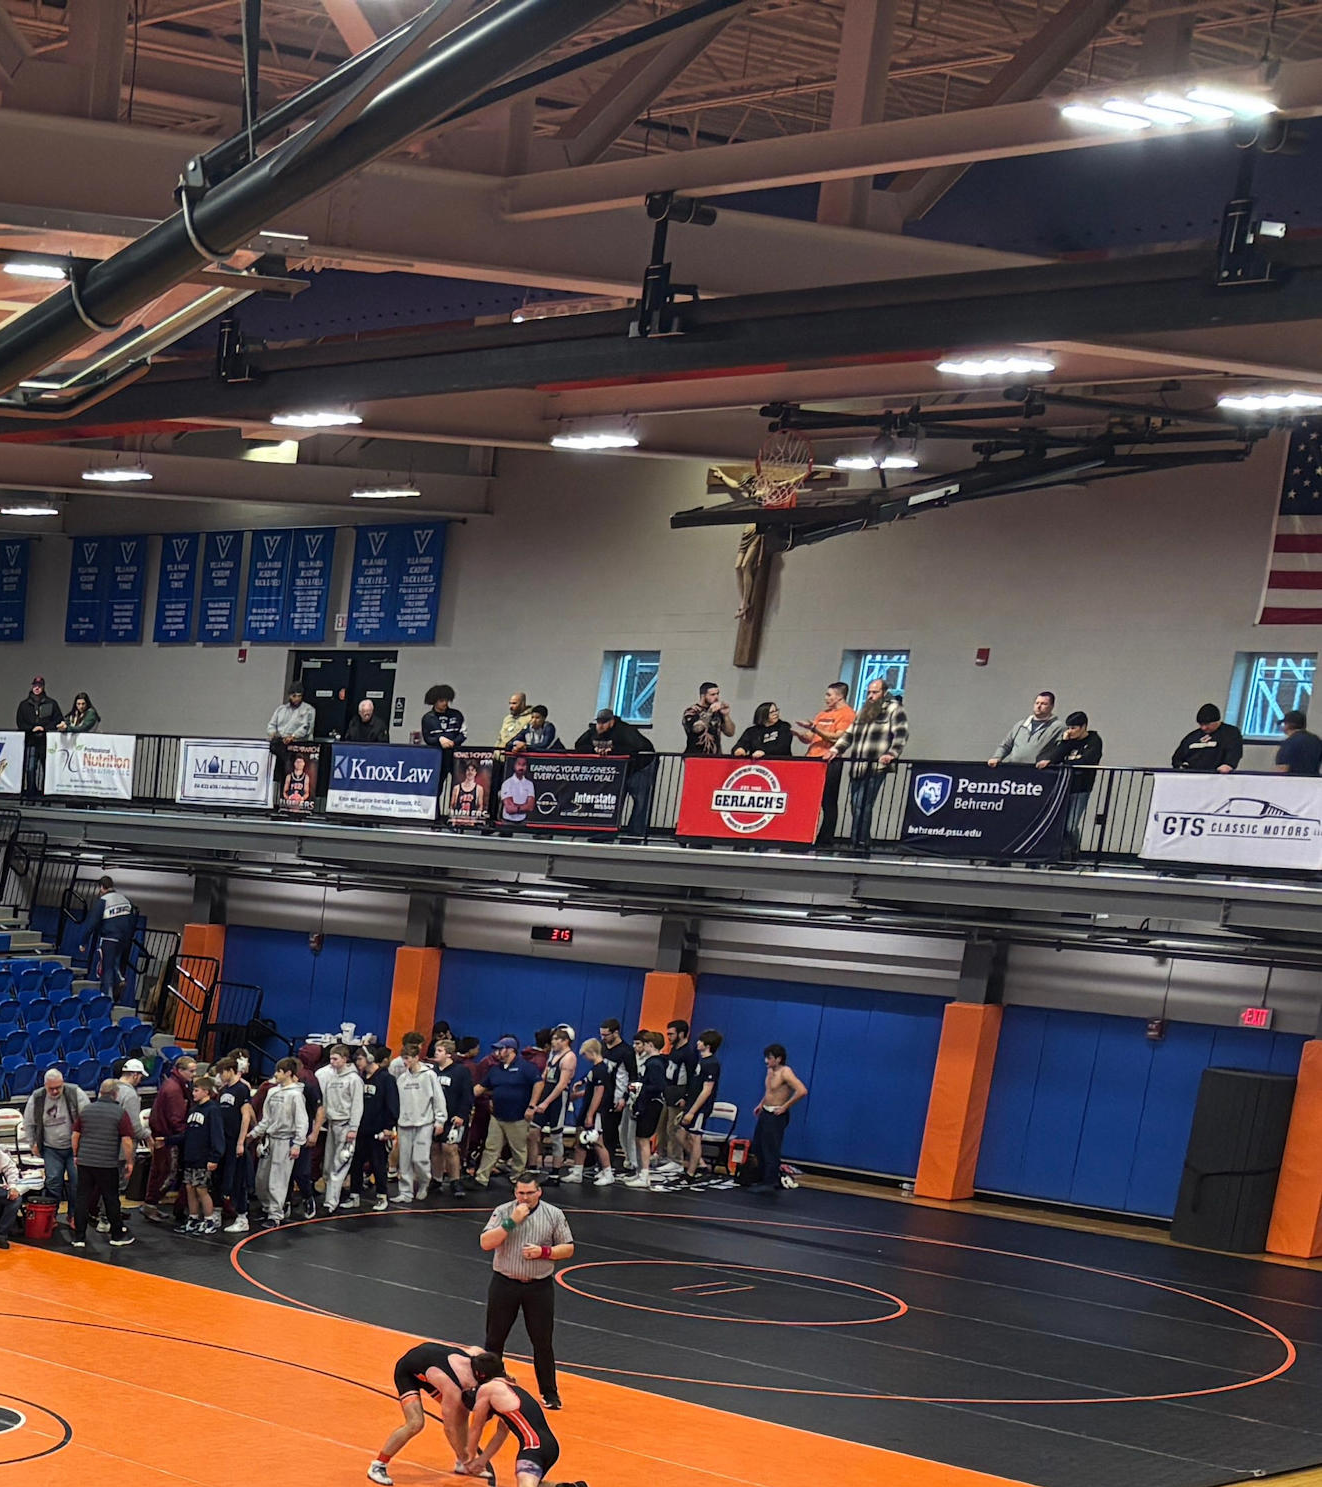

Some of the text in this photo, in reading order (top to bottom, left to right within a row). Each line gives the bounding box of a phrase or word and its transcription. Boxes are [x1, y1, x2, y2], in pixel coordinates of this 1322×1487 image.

[82, 752, 131, 770] Nutrition
[529, 763, 560, 773] EARNING
[560, 764, 581, 774] YOUR
[350, 758, 434, 784] KnoxLaw
[533, 771, 555, 781] EVERY
[956, 778, 1044, 797] PennState
[574, 791, 617, 805] Interstate
[714, 794, 784, 810] GERLACH'S
[953, 797, 1005, 811] Behrend
[907, 824, 983, 839] behrend.psu.edu
[1162, 816, 1206, 837] GTS
[1211, 822, 1311, 837] CLASSIC MOTORS
[1243, 1008, 1269, 1028] EXIT
